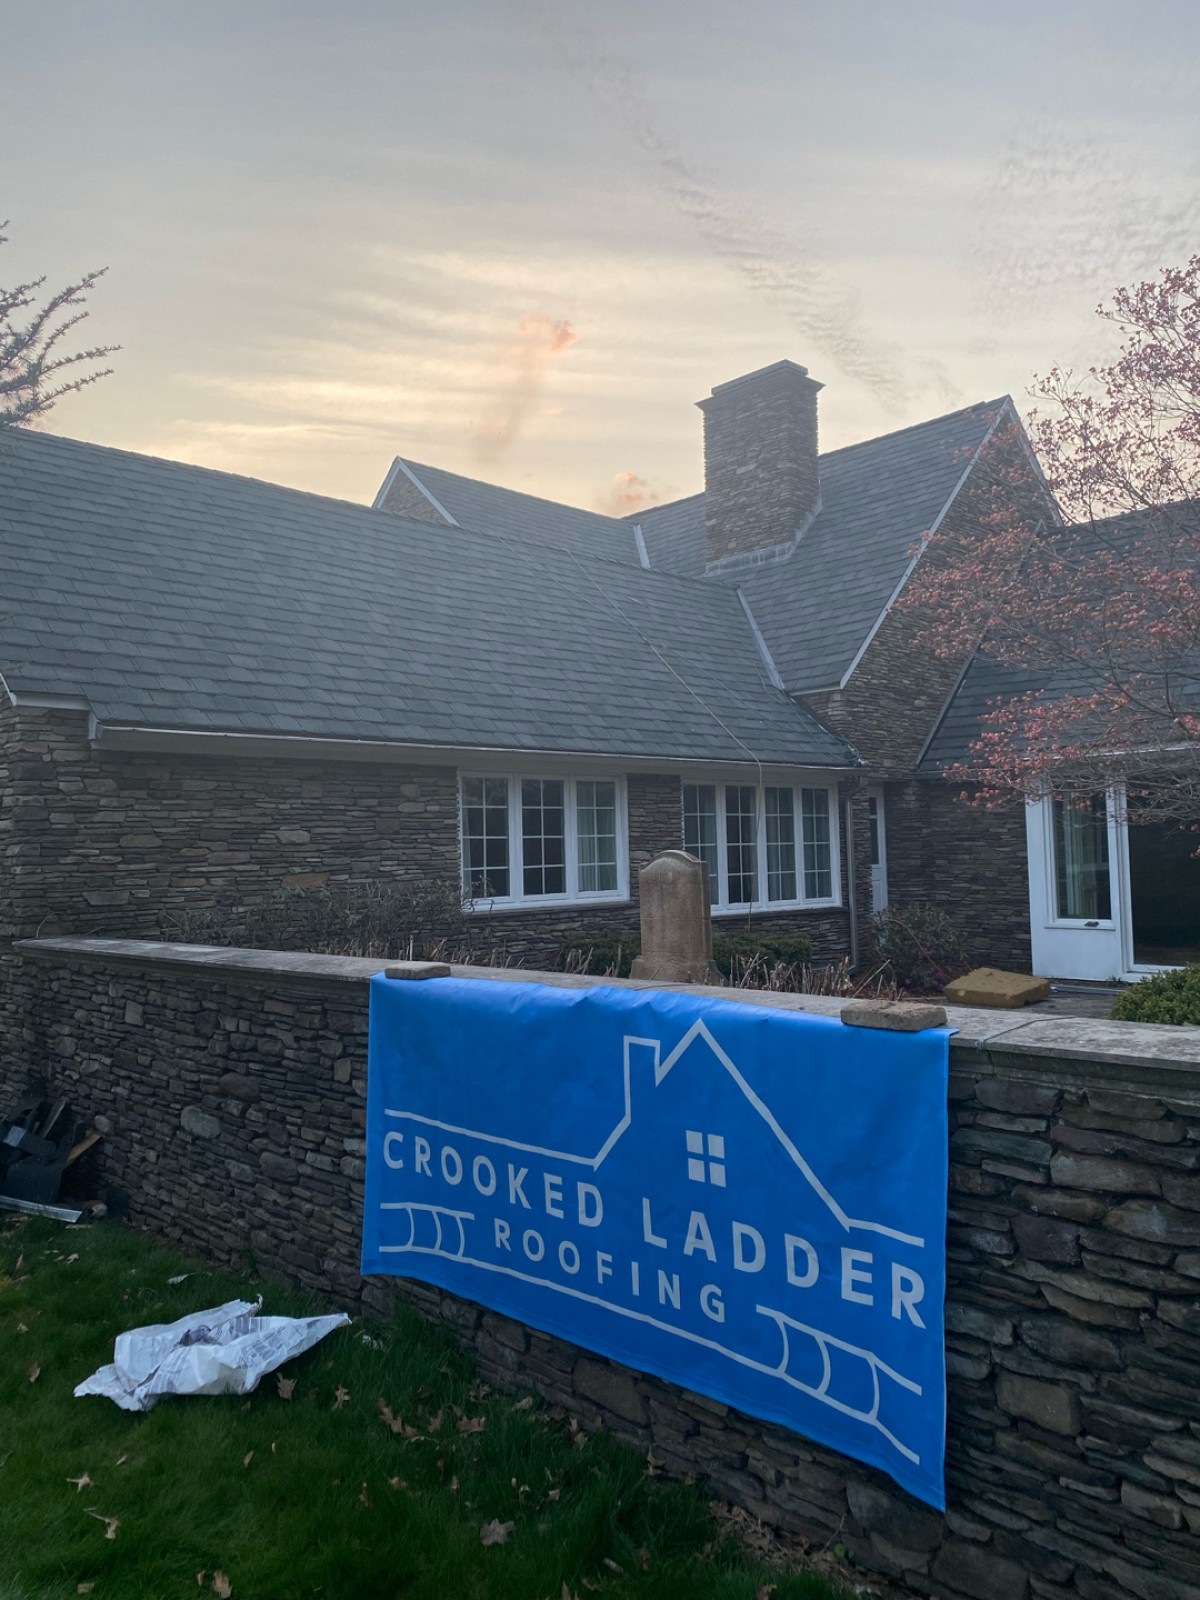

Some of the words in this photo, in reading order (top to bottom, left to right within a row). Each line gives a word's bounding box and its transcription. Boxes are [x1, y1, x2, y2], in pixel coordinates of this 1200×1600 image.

[383, 1131, 604, 1227] CROOKED
[642, 1197, 927, 1329] LADDER
[494, 1218, 726, 1323] ROOFING
